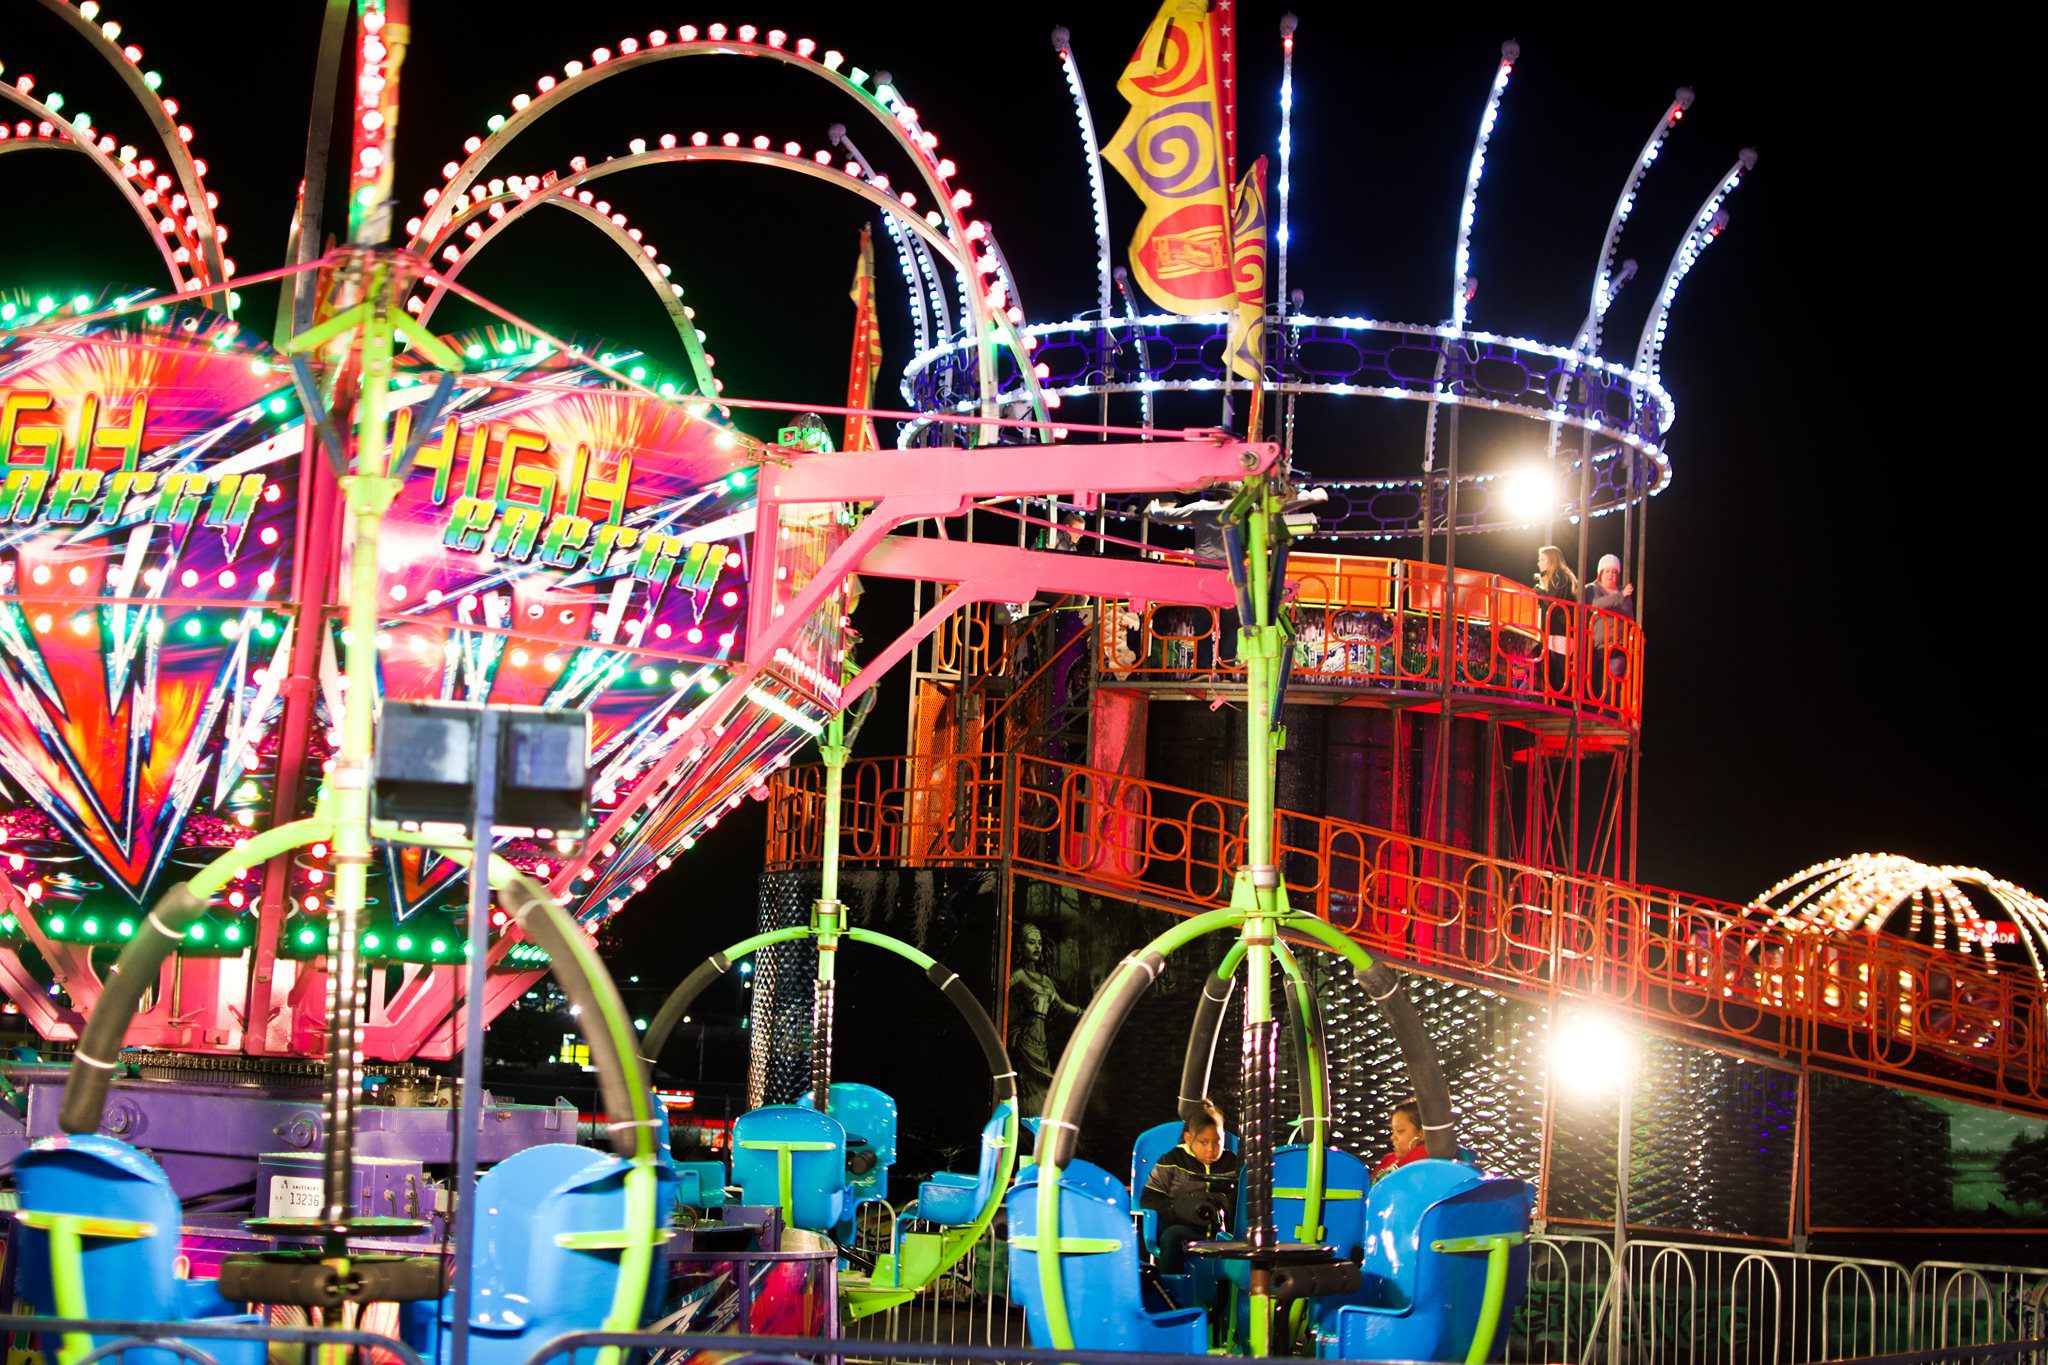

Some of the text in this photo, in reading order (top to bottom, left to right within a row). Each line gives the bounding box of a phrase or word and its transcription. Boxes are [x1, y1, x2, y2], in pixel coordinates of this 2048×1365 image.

[387, 406, 633, 526] HIGH
[443, 496, 730, 625] energy
[290, 1192, 320, 1206] 13236
